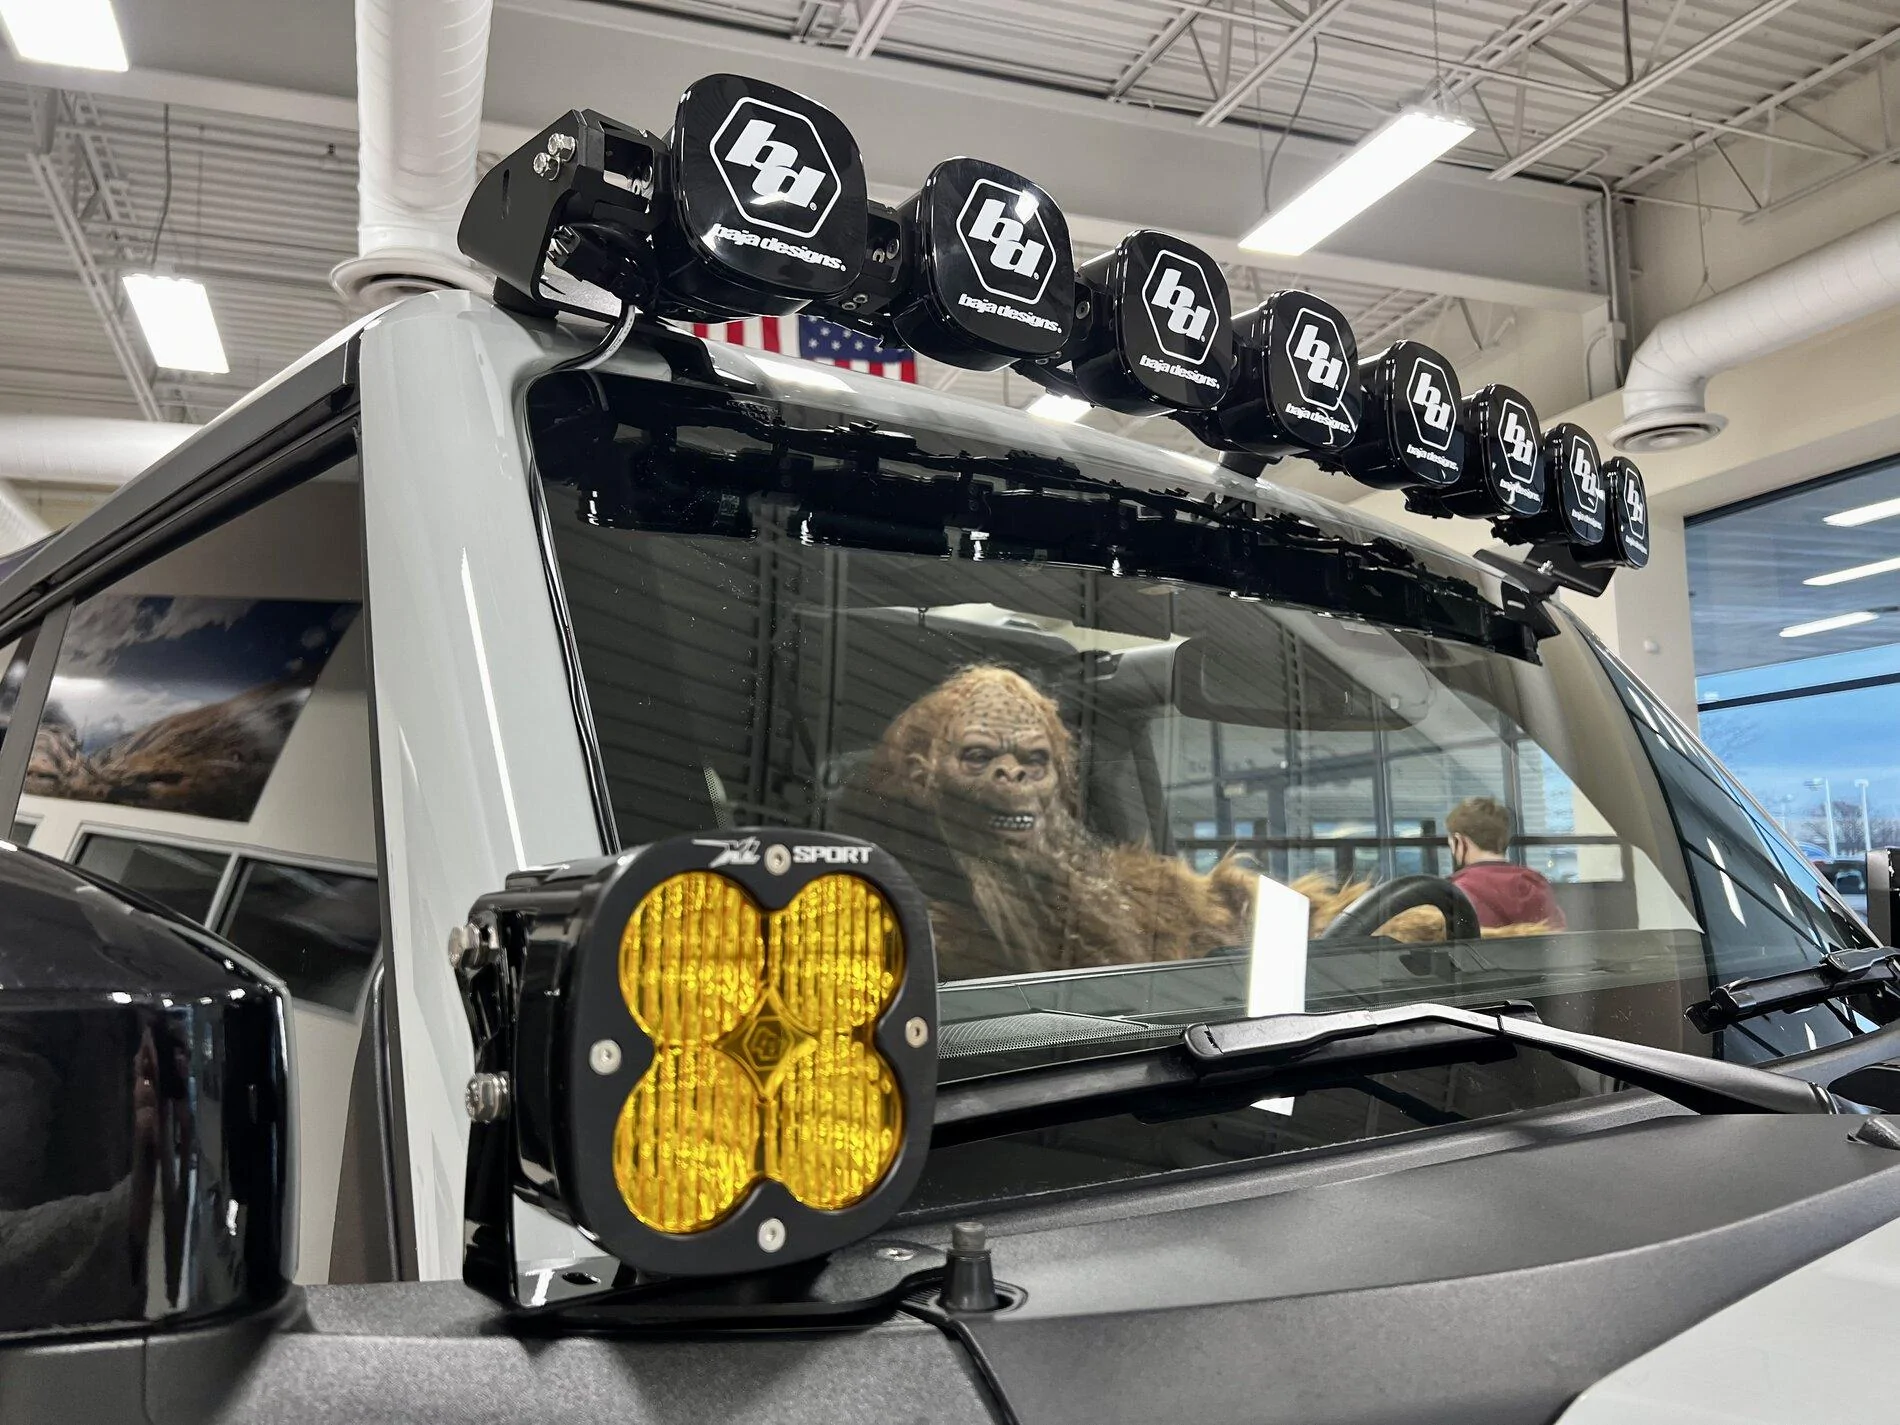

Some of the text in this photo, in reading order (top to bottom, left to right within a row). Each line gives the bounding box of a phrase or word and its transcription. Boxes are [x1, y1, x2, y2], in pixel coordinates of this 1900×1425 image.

[725, 119, 826, 209] bd
[712, 223, 759, 248] baja
[968, 198, 1045, 277] bd
[958, 293, 997, 314] baja
[1151, 268, 1211, 341] bd
[1139, 355, 1170, 373] baja
[1293, 324, 1342, 389] bd
[1285, 403, 1313, 420] baja
[1413, 372, 1451, 431] bd
[1406, 443, 1428, 460] baja
[792, 845, 873, 864] SPORT
